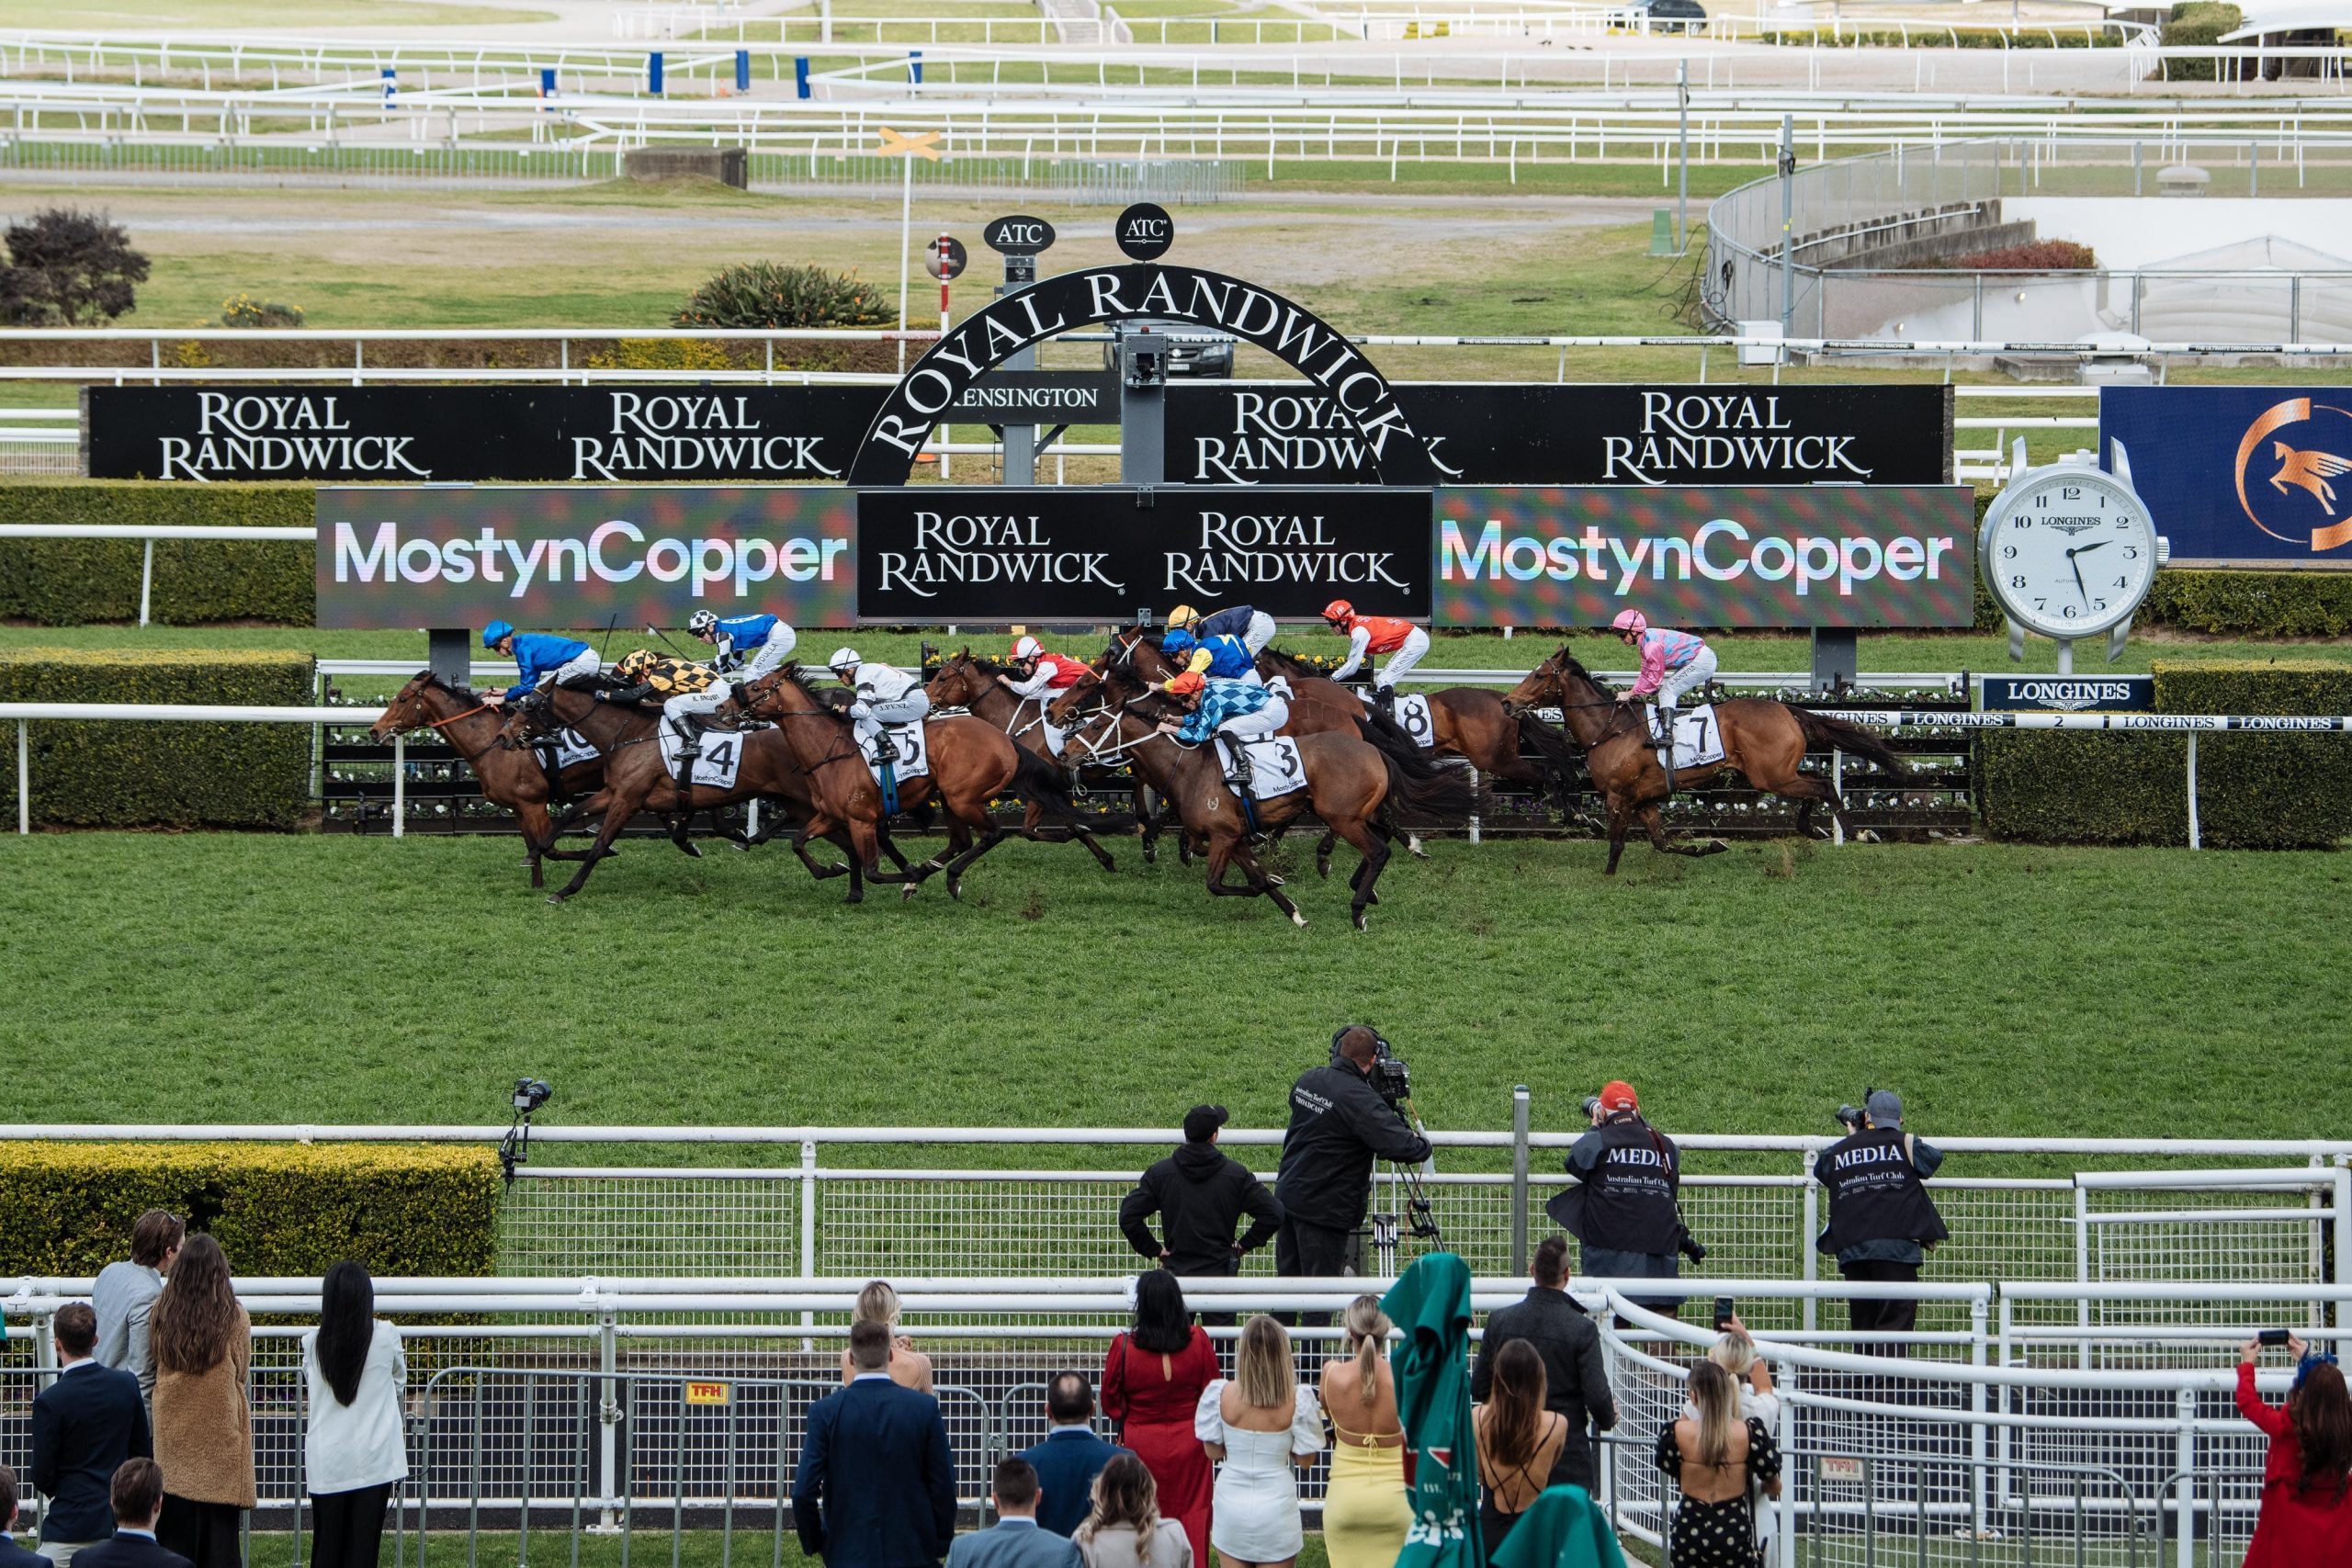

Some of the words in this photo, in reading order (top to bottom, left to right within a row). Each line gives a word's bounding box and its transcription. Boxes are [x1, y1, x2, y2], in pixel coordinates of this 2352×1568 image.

[996, 224, 1043, 243] ATC
[1125, 218, 1164, 237] ATC
[872, 293, 1066, 459] ROYAL
[1084, 271, 1416, 462] RANDWICK
[953, 389, 1099, 407] ENSINGTON
[198, 393, 349, 440] ROYAL
[610, 393, 760, 440] ROYAL
[1233, 393, 1353, 443] ROYA
[1641, 392, 1792, 440] ROYAL
[159, 437, 433, 479] RANDWICK
[571, 437, 842, 479] RANDWICK
[1194, 437, 1467, 484] RANDWK
[1602, 436, 1873, 484] RANDWICK
[2036, 496, 2047, 508] 11
[2063, 488, 2081, 500] 12
[2100, 496, 2105, 508] 1
[2015, 516, 2031, 528] 10
[2041, 516, 2101, 525] LONGINES
[2116, 516, 2130, 529] 2
[914, 513, 1051, 556] ROYAL
[1199, 513, 1336, 556] ROYAL
[334, 520, 848, 598] MostynCopper
[1442, 519, 1953, 596] MostynCopper
[2004, 546, 2018, 558] 9
[2123, 547, 2137, 559] 3
[878, 553, 1125, 596] RANDWICK
[1164, 553, 1410, 596] RANDWICK
[2012, 575, 2027, 589] 8
[2113, 576, 2128, 589] 4
[2034, 598, 2047, 611] 7
[2063, 605, 2076, 619] 6
[2094, 598, 2107, 611] 5
[2008, 682, 2131, 700] LONGINES
[1404, 701, 1428, 736] 8
[1912, 713, 2005, 726] LONGINES
[2054, 716, 2064, 727] 2
[2123, 716, 2215, 728] LONGINES
[2240, 716, 2332, 729] LONGINES
[1689, 716, 1709, 753] 7
[706, 740, 734, 775] 4
[902, 730, 920, 766] 5
[1275, 743, 1298, 778] 3
[1834, 1145, 1904, 1171] MEDIA
[1606, 1174, 1642, 1184] Australian
[1642, 1176, 1658, 1185] Turf
[1868, 1172, 1885, 1181] Turf
[1885, 1171, 1905, 1180] Club
[692, 1385, 723, 1397] TFH
